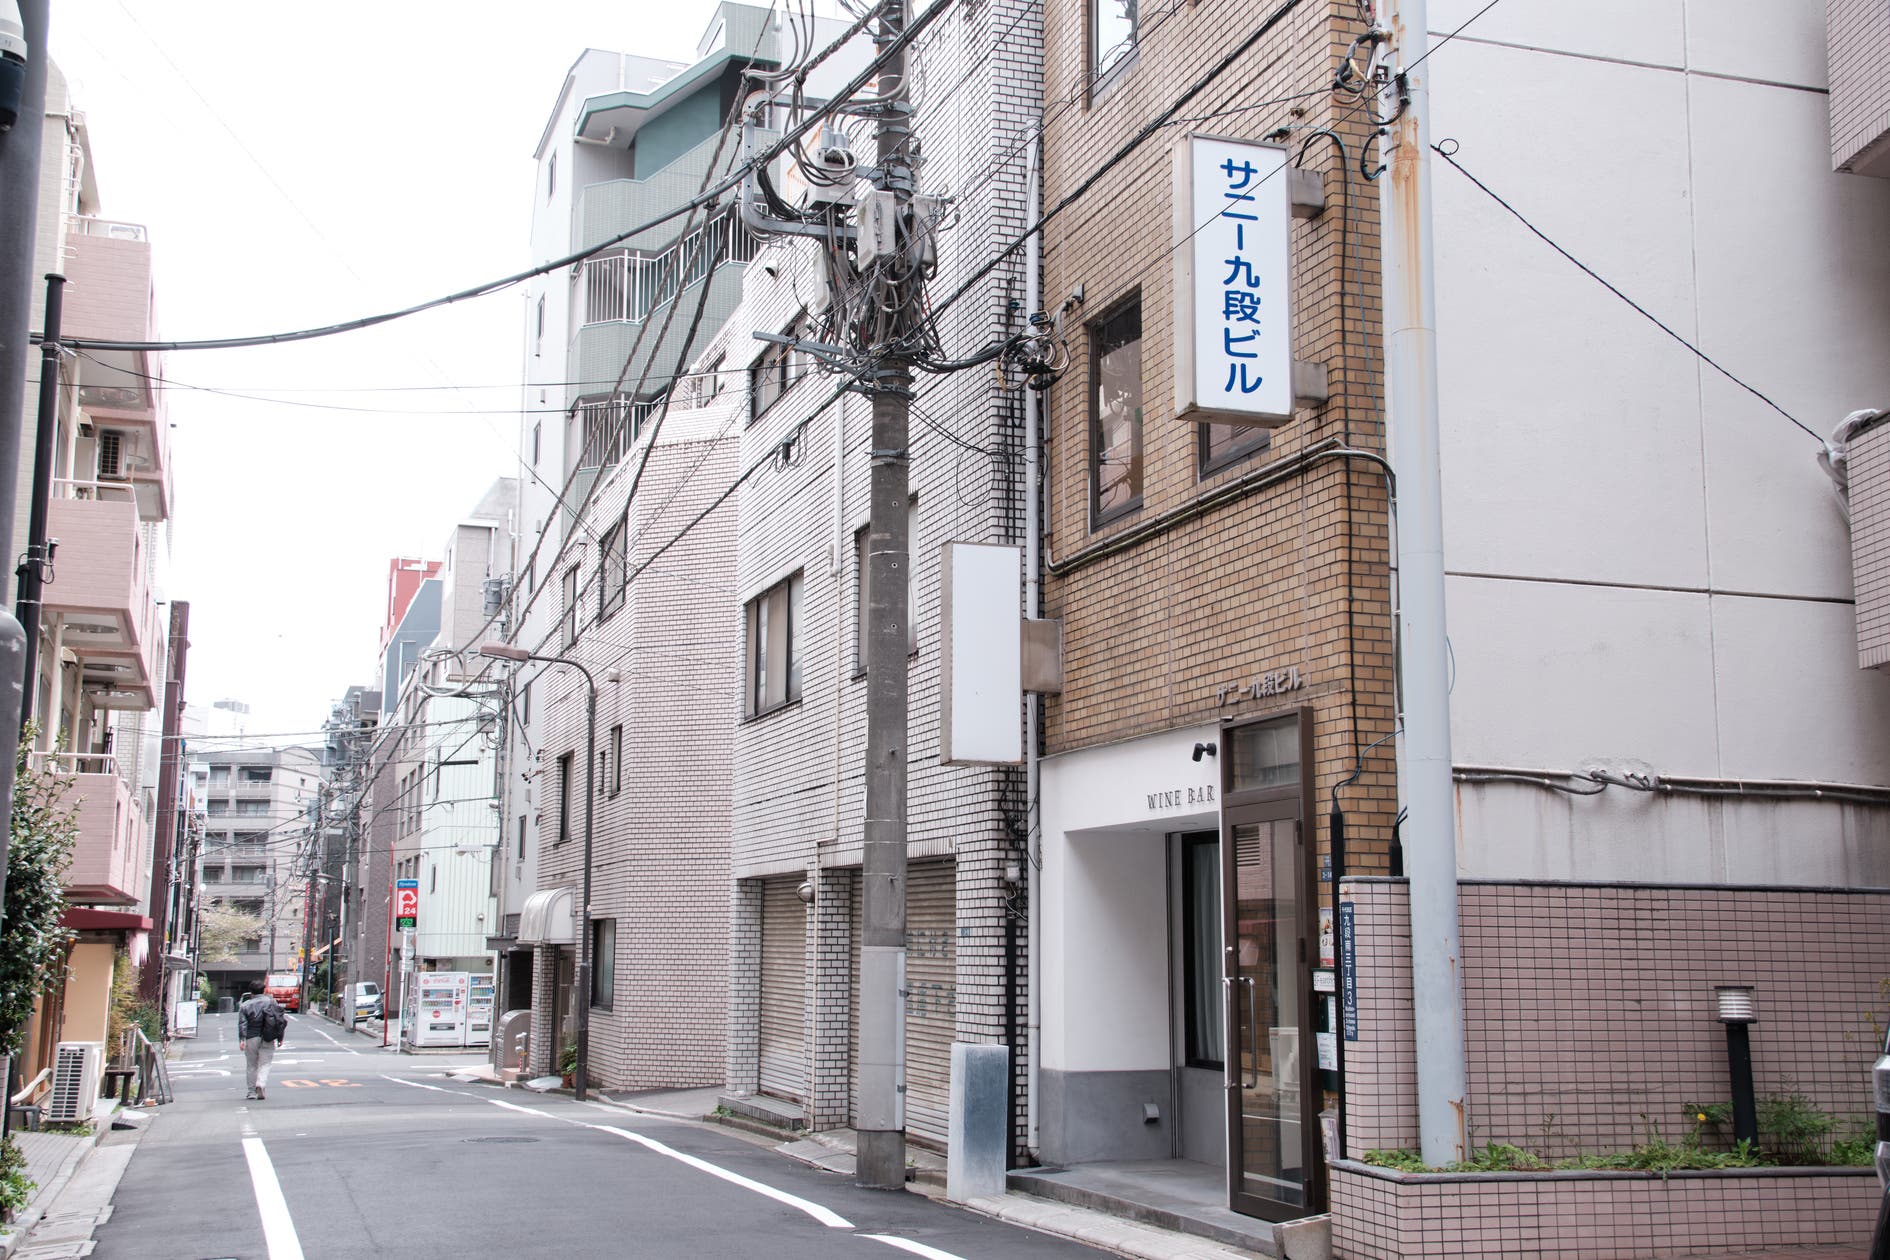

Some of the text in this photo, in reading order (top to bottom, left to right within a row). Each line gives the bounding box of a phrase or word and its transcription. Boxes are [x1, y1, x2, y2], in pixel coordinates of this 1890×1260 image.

[1220, 158, 1263, 394] サニー九段ビル
[1216, 665, 1303, 707] サニー九段ビル
[1147, 785, 1215, 809] WINE BAR
[404, 907, 416, 915] 24
